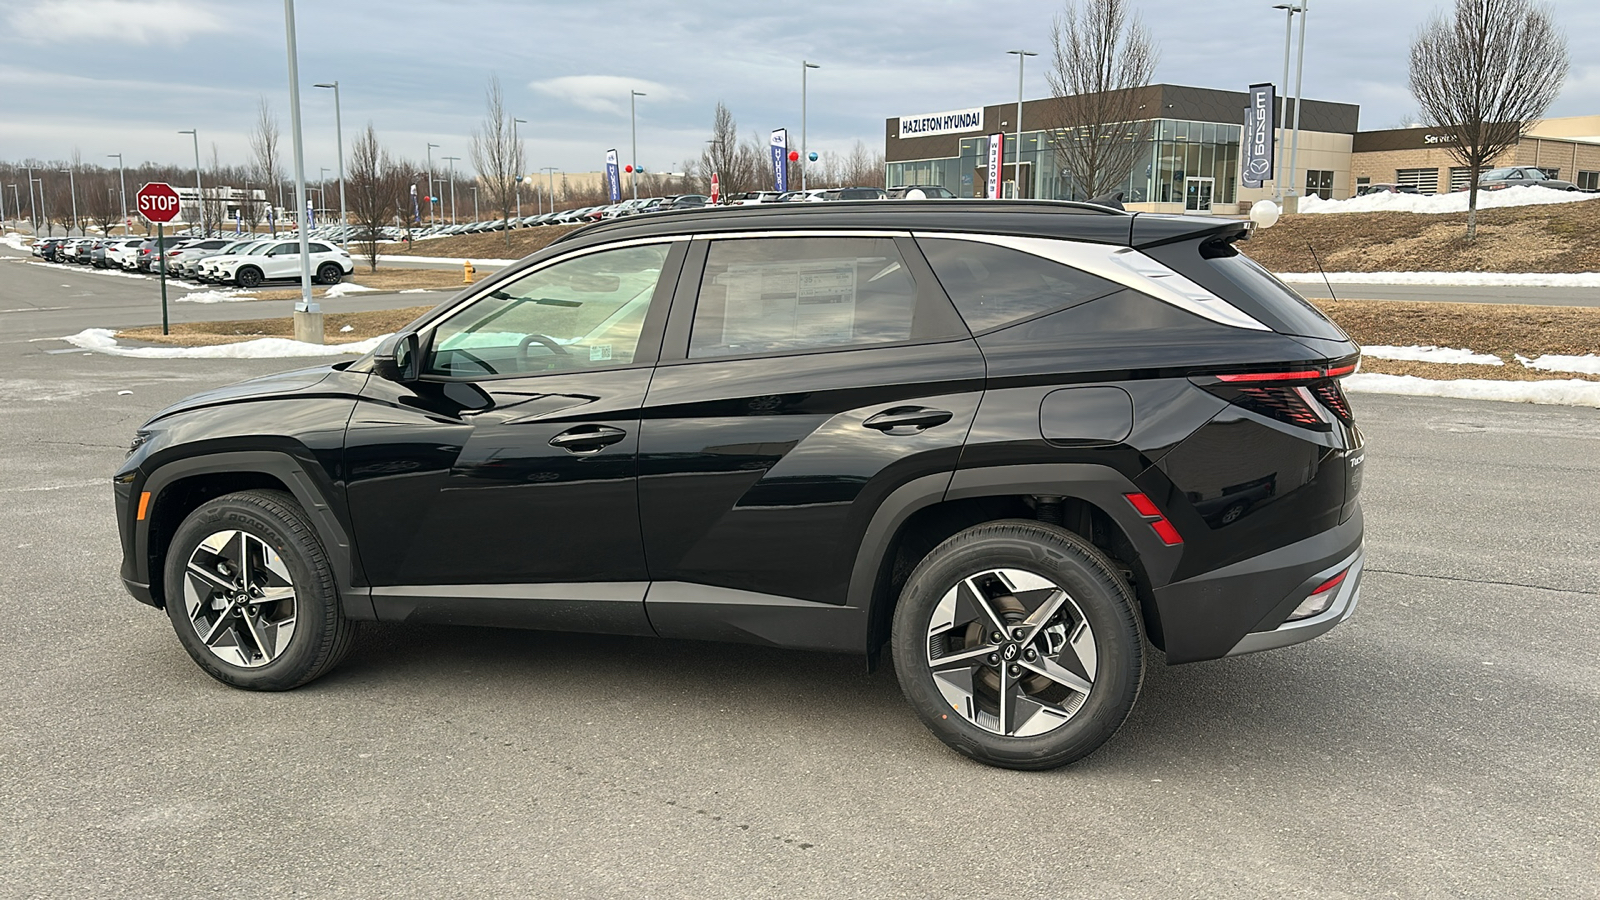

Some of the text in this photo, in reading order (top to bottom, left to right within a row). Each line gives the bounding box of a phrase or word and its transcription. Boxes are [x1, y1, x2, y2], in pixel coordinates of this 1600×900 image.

[902, 112, 980, 134] HAZLETON HYUNDAI
[774, 148, 783, 191] HYUNDAI
[140, 195, 177, 210] STOP
